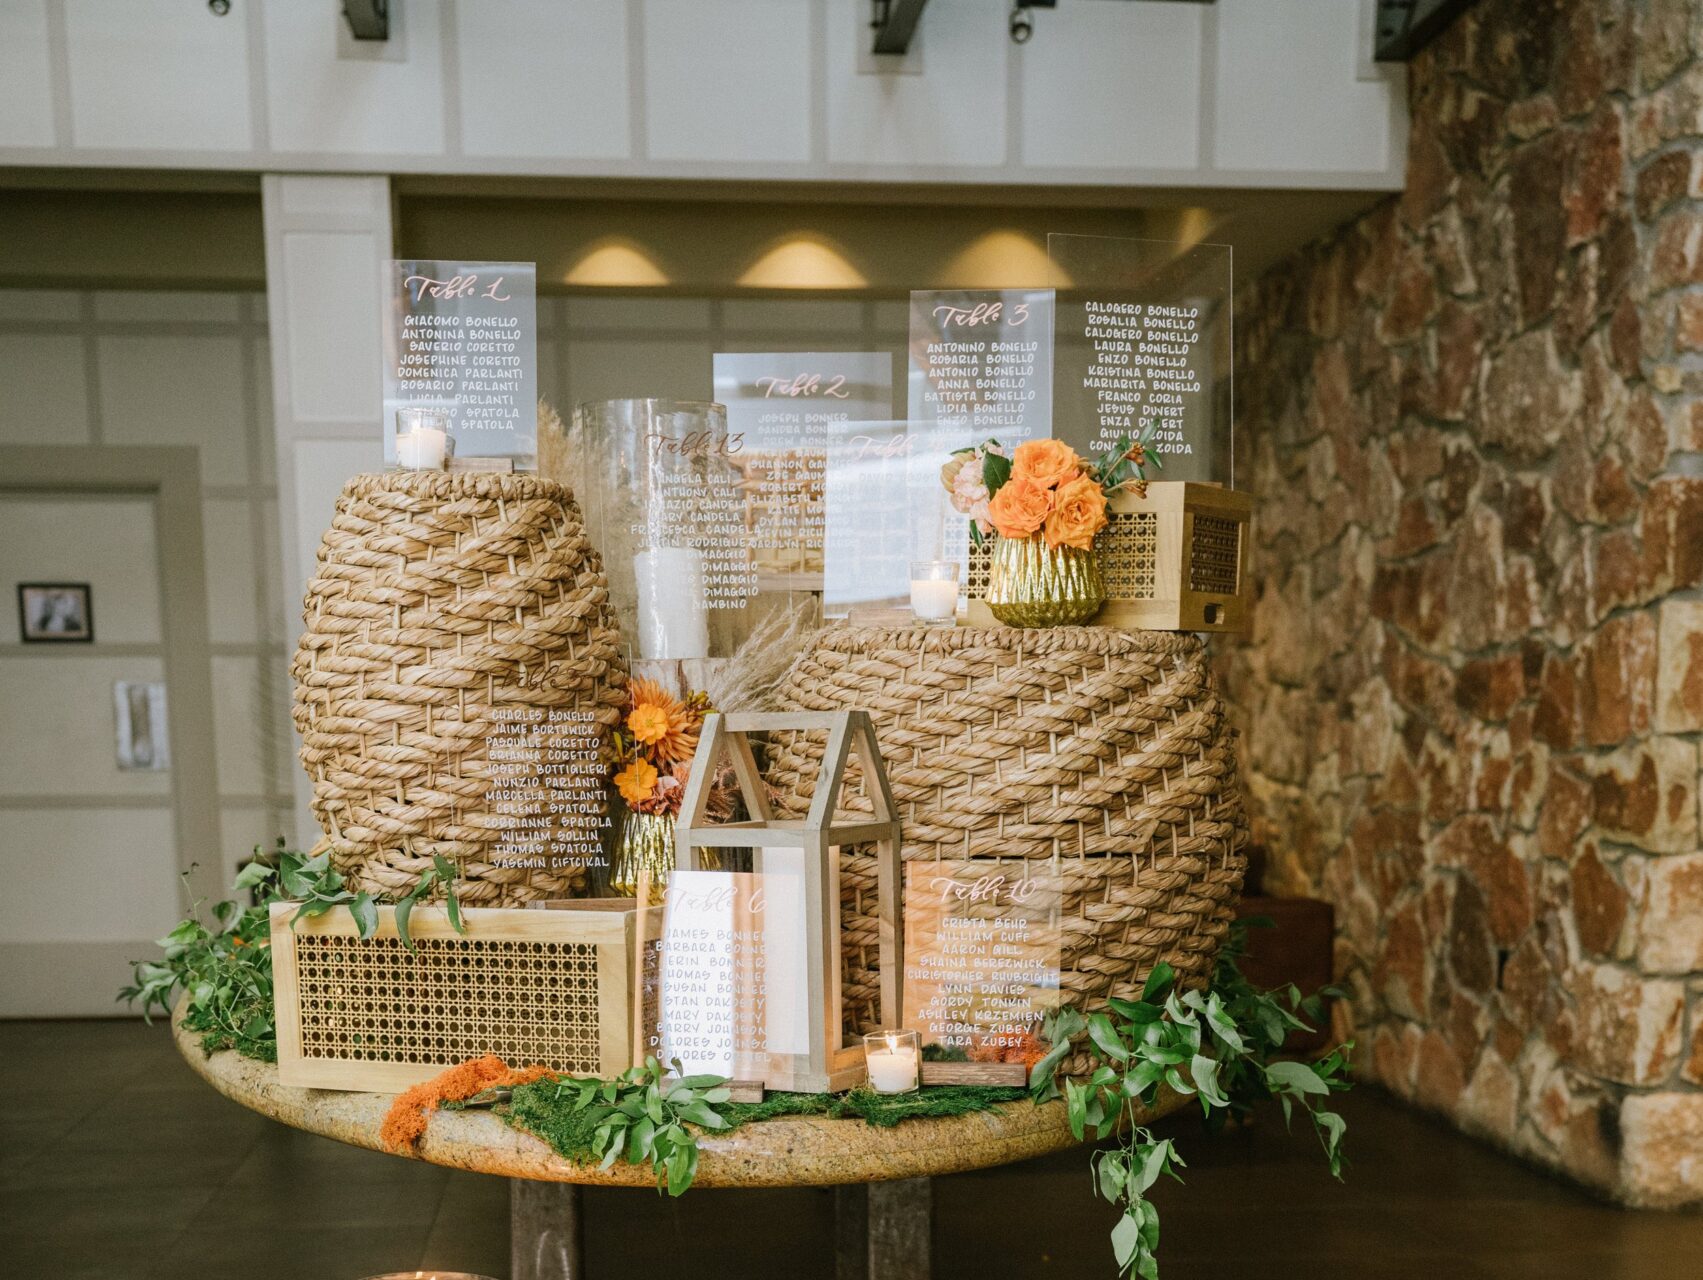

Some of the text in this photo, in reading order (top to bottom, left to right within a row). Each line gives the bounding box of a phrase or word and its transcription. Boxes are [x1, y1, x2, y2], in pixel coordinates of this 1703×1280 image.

[404, 275, 511, 301] Table 1
[933, 302, 1029, 328] Table 3
[1086, 302, 1198, 318] CALOGERO BONELLO
[404, 315, 517, 327] GIACOMO BONELLO
[1089, 315, 1195, 330] ROSALIA BONELLO
[402, 329, 520, 340] ANTONINA BONELLO
[1085, 327, 1198, 343] CALOGERO BONELLO
[410, 342, 515, 352] SAVERIO CORETTO
[927, 342, 1038, 353] ANTONINO BONELLO
[1095, 341, 1189, 354] LAURA BONELLO
[400, 355, 520, 366] JOSEPHINE CORETTO
[930, 355, 1034, 364] ROSARIA BONELLO
[1098, 354, 1186, 367] ENZO BONELLO
[398, 368, 522, 379] DOMENICA PARLANTI
[929, 367, 1033, 377] ANTONIO BONELLO
[1089, 366, 1195, 379] KRISTINA BONELLO
[400, 381, 518, 391] ROSARIO PARLANTI
[756, 373, 849, 399] Table 2
[938, 379, 1025, 389] ANNA BONELLO
[1084, 378, 1200, 392] MARIARITA BONELLO
[455, 394, 513, 404] PARLANTI
[925, 391, 1035, 401] BATTISTA BONELLO
[1098, 391, 1182, 403] FRANCO CORIA
[466, 408, 519, 417] SPATOLA
[937, 403, 1024, 413] LIDIA BONELLO
[1097, 404, 1185, 416] JESUS DUVERT
[461, 420, 513, 430] SPATOLA
[974, 415, 1023, 425] BONELLO
[1100, 416, 1131, 426] ENZA
[644, 431, 745, 457] Table 13
[1156, 443, 1192, 453] ZOIDA
[708, 474, 731, 483] CALI
[713, 488, 736, 497] CALI
[690, 513, 740, 522] CANDELA
[492, 709, 594, 721] CHARLES BONELLO
[493, 724, 594, 734] JAIME BORTHWICK
[486, 737, 599, 748] PASQUALE CORETTO
[489, 750, 598, 761] BRIANNA CORETTO
[486, 764, 607, 774] JOSEPH BOTTIGLIERI
[493, 777, 599, 788] NUNZIO PARLANTI
[486, 790, 607, 801] MARCELLA PARLANTI
[550, 804, 599, 813] SPATOLA
[561, 817, 612, 827] SPATOLA
[501, 830, 598, 841] WILLIAM SOLLIN
[495, 844, 603, 854] THOMAS SPATOLA
[493, 857, 609, 868] YASEMIN CIFTCIKAL
[930, 876, 1037, 903] Table 10
[662, 887, 768, 913] Table 6
[942, 918, 1027, 929] CRISTA BEHR
[937, 932, 1030, 941] WILLIAM CUFF
[942, 945, 1023, 954] AARON GILL
[920, 958, 1046, 968] SHAINA BEREZWICK
[908, 971, 1059, 981] CHRISTOPHER RHUBRIGHT
[938, 984, 1025, 993] LYNN DAVIES
[931, 997, 1031, 1008] GORDY TONKIN
[919, 1010, 1044, 1020] ASHLEY KRZEMIEN
[930, 1023, 1031, 1034] GEORGE ZUBEY
[938, 1036, 1022, 1047] TARA ZUBEY
